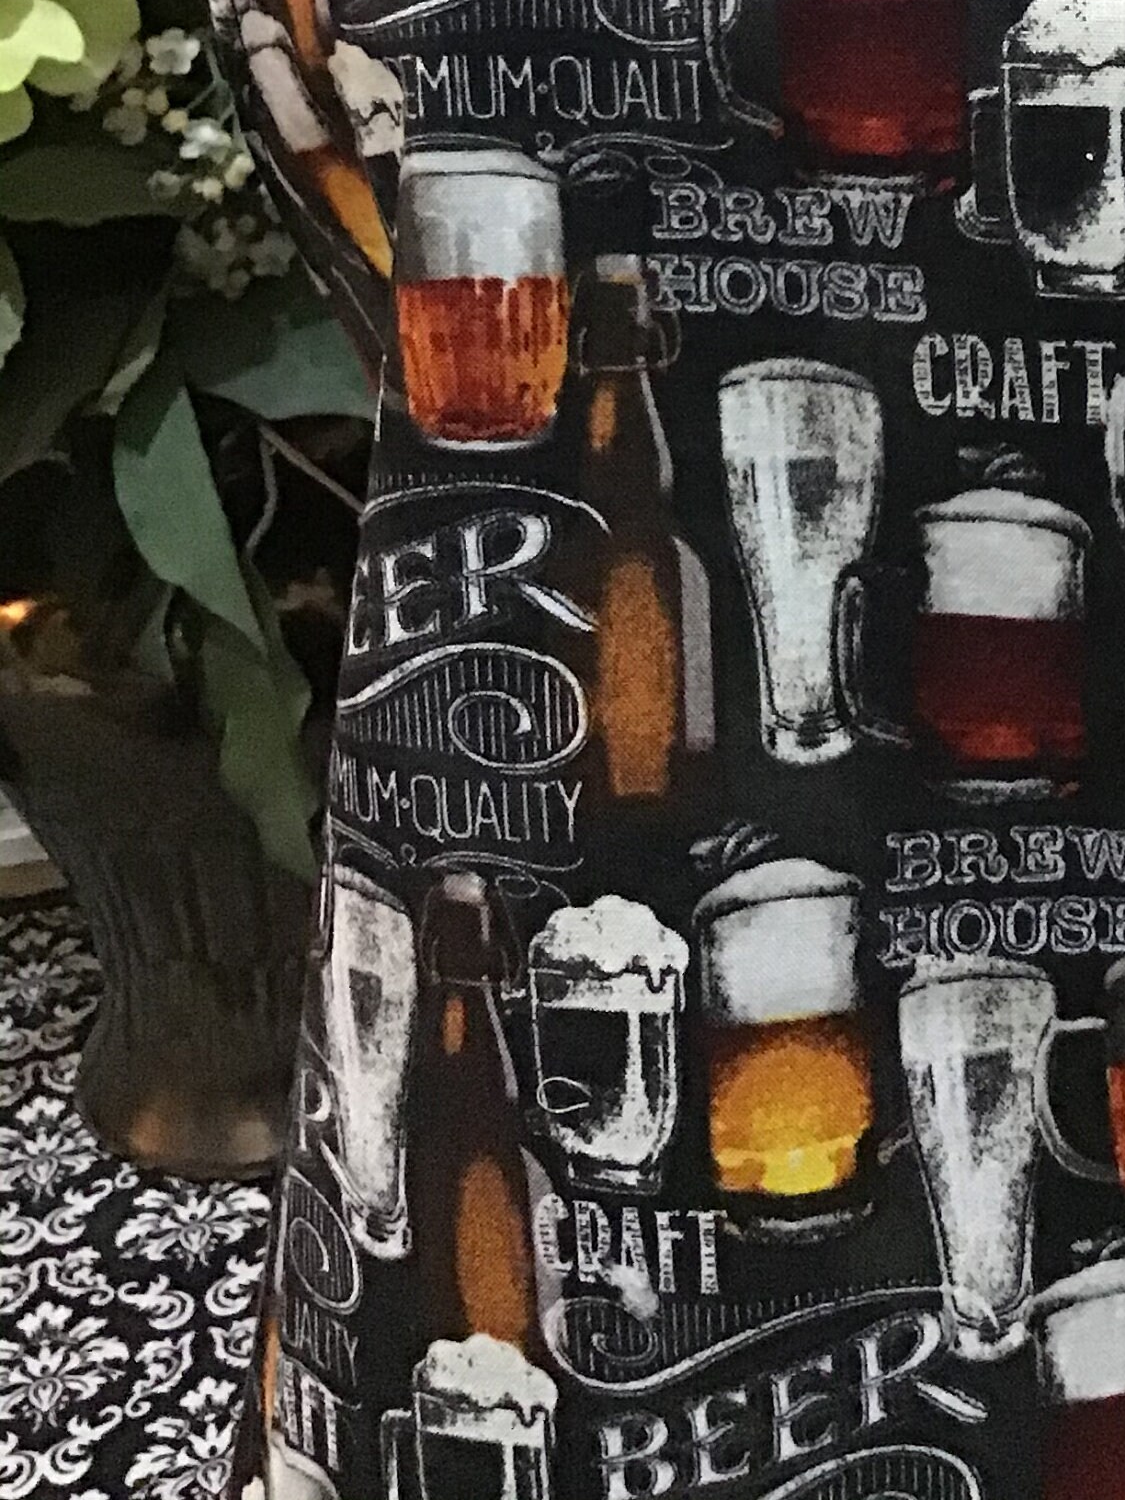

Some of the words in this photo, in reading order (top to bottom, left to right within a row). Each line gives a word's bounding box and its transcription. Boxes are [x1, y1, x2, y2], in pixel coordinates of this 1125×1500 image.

[650, 181, 914, 249] BREW
[646, 252, 926, 322] HOUSE
[911, 332, 1117, 425] CRAFT
[536, 1192, 728, 1295] CRAFT
[596, 1306, 990, 1500] BEER
